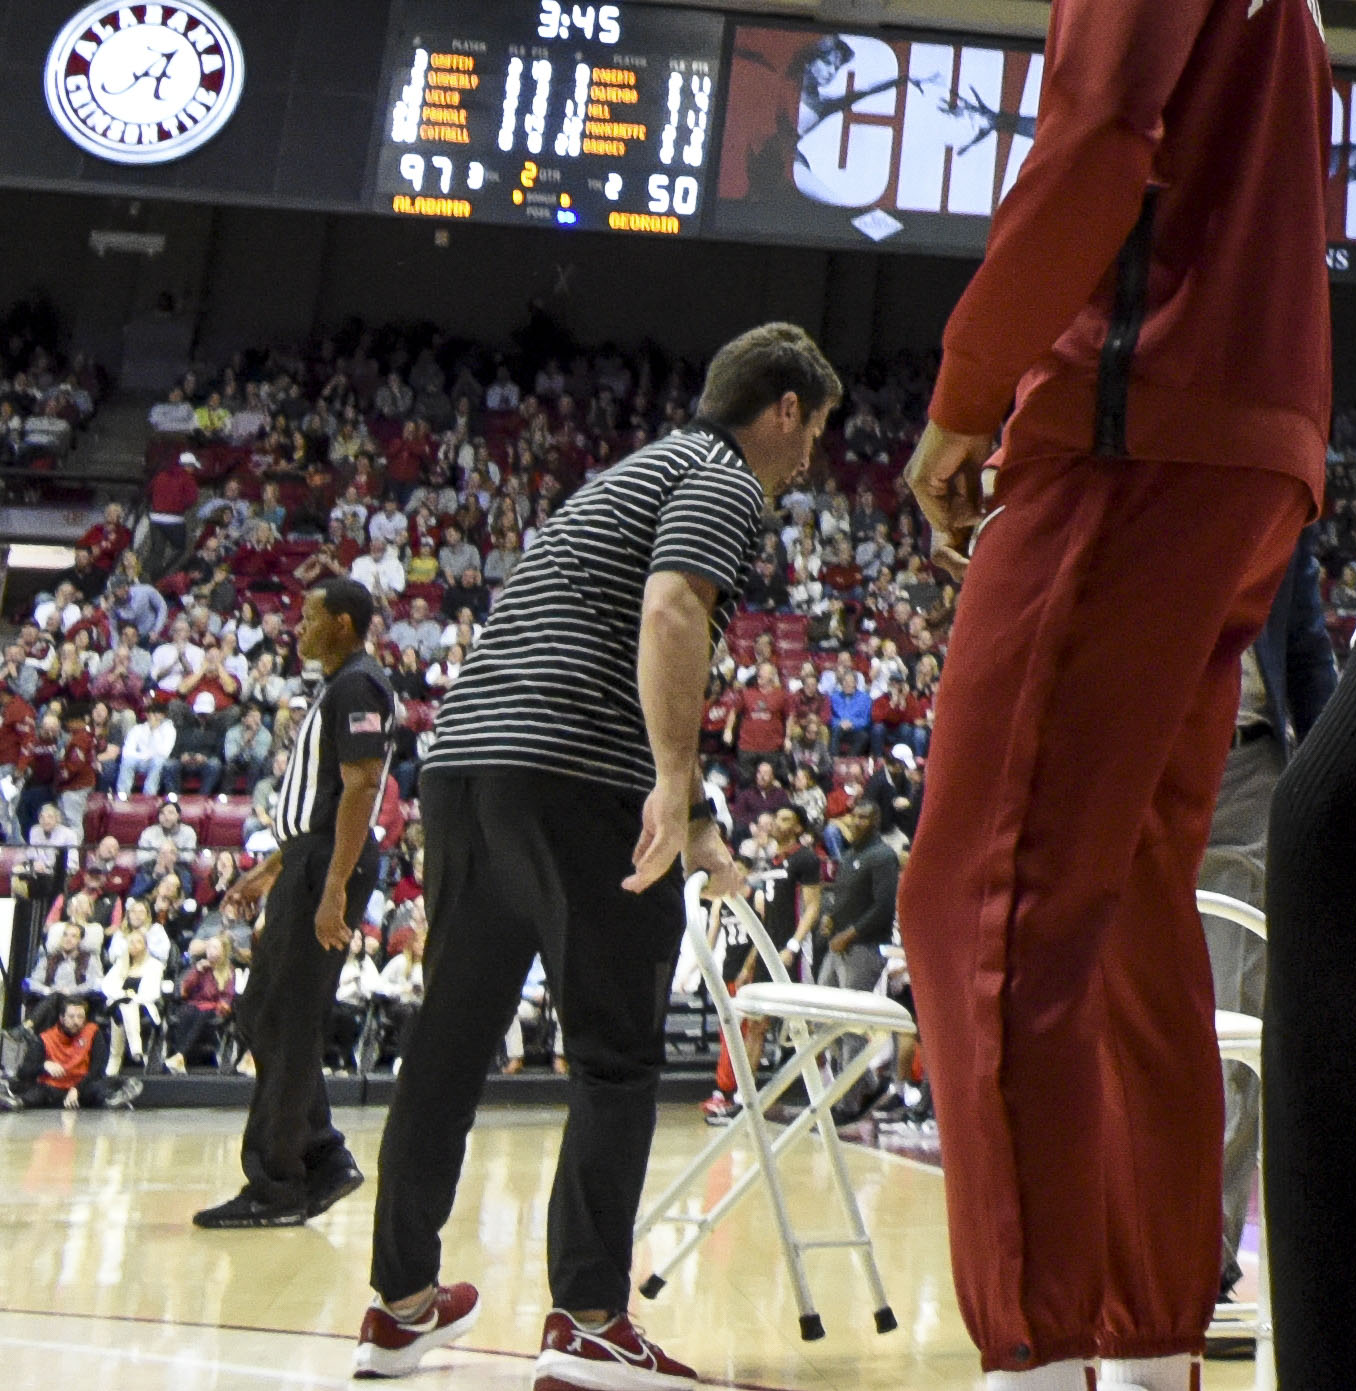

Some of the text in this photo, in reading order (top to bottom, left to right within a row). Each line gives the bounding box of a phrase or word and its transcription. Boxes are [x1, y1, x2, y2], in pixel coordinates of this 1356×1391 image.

[74, 4, 224, 76] ALABAMA
[537, 0, 621, 44] 3:45
[65, 73, 159, 145] CRIMSON
[400, 153, 453, 194] 97
[647, 173, 699, 215] 50
